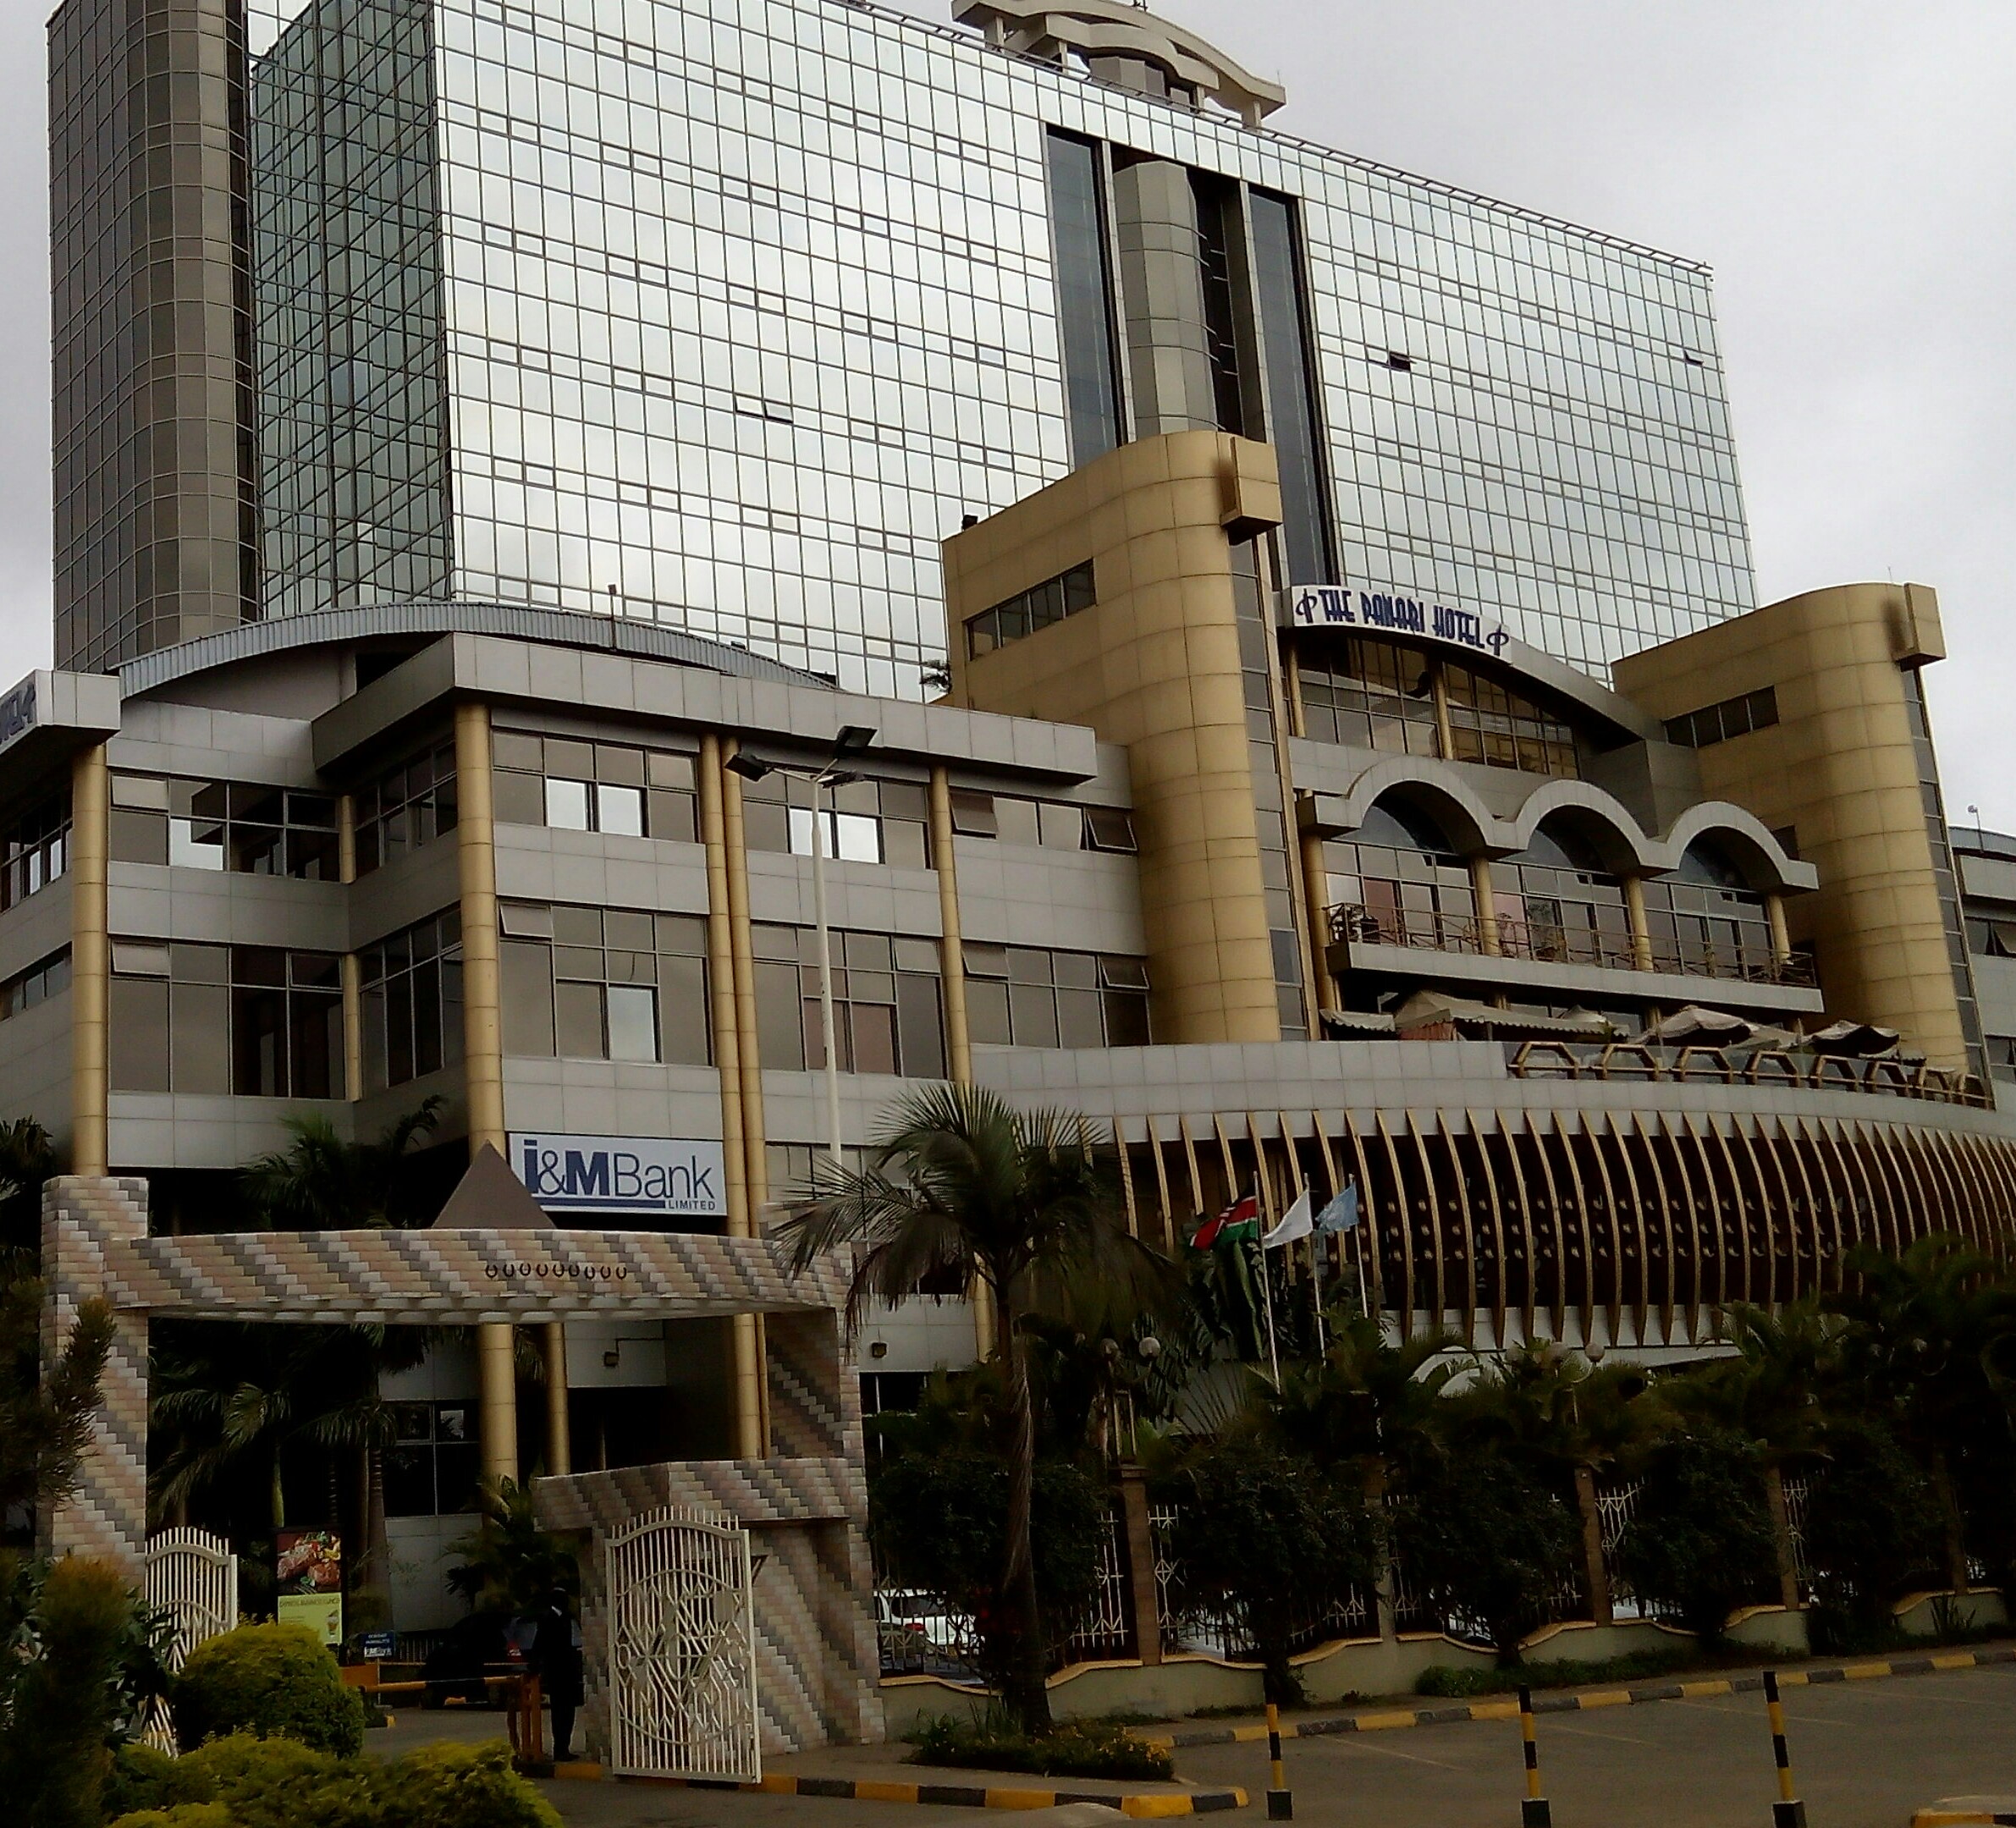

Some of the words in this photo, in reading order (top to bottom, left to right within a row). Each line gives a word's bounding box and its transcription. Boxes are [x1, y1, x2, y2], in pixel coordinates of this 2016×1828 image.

[1319, 590, 1356, 623] THE
[1360, 592, 1425, 633] PANARI
[1432, 605, 1485, 649] HOTEL
[668, 1201, 716, 1211] LIMITED
